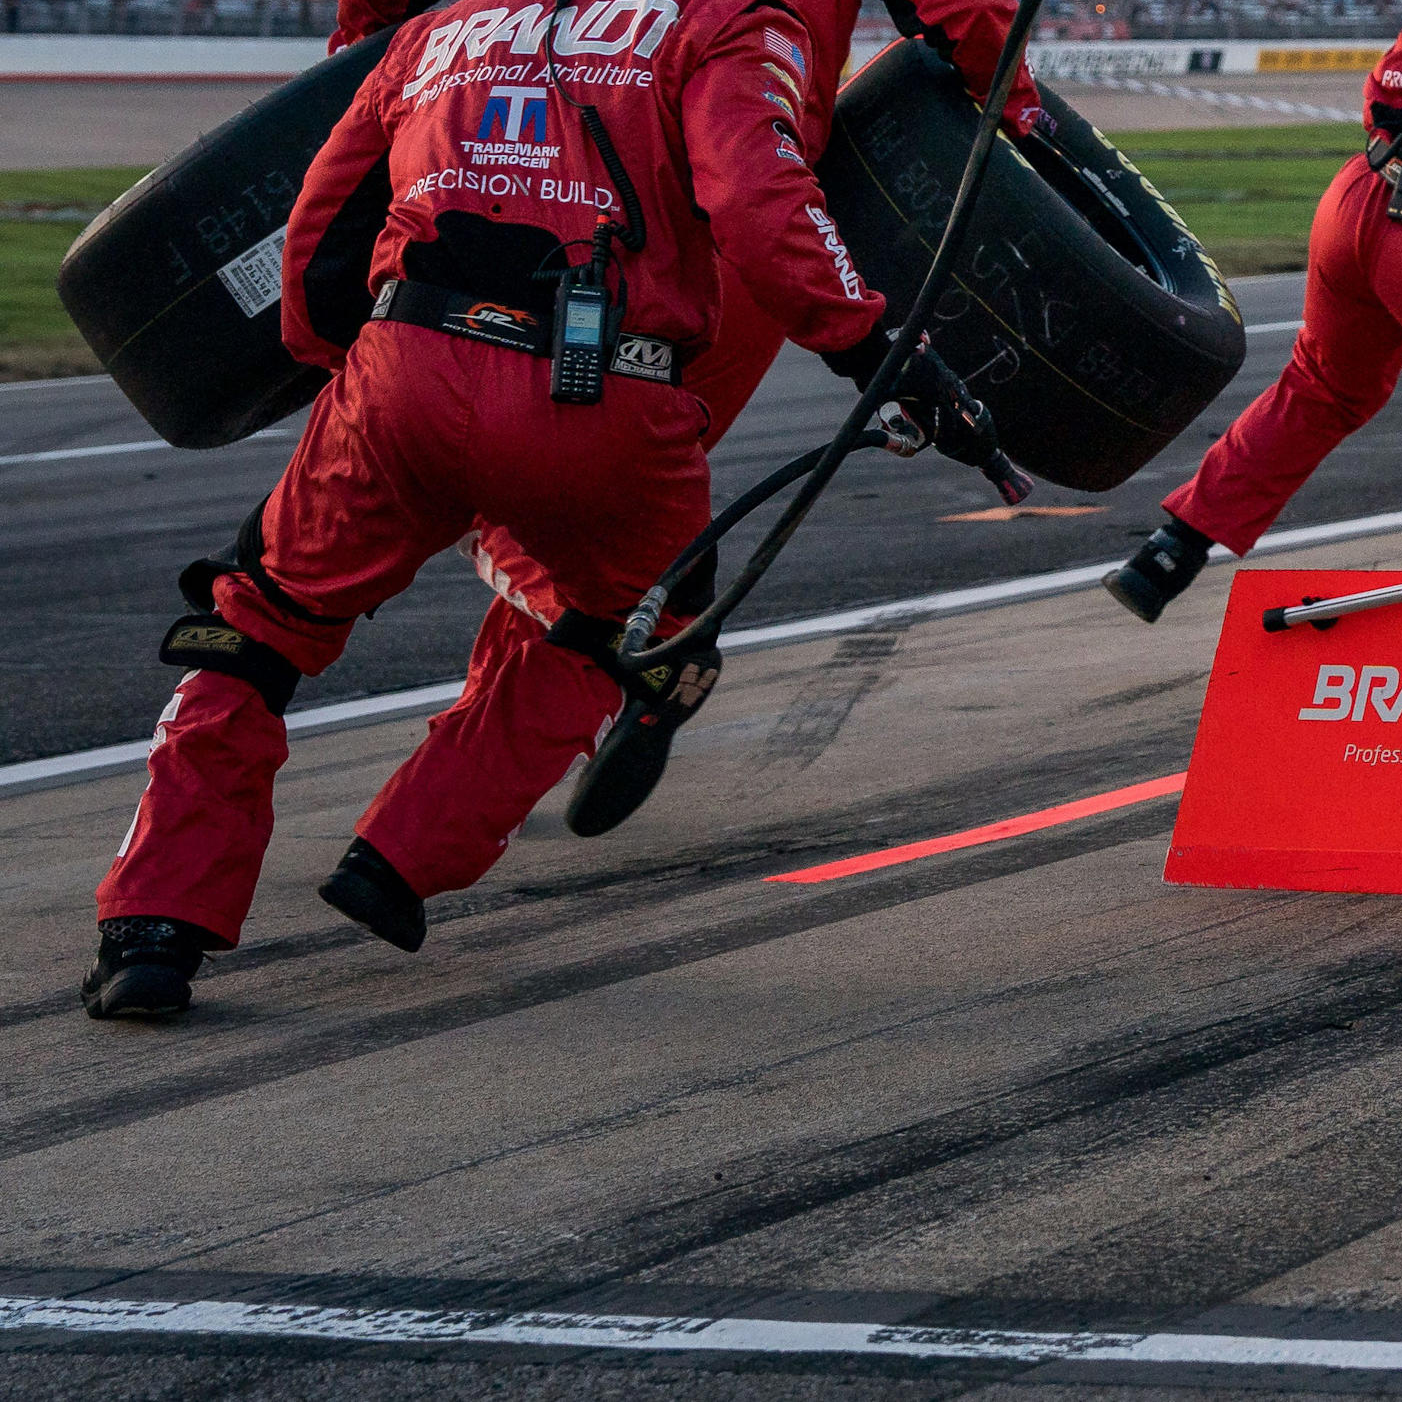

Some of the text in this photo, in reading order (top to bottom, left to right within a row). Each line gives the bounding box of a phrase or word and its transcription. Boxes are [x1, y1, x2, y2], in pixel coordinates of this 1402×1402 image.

[413, 61, 654, 113] Professional Agriculture
[470, 154, 551, 170] NITROGEN
[404, 167, 614, 210] PRECISION BUILD
[441, 322, 536, 350] MOTORSPORTS
